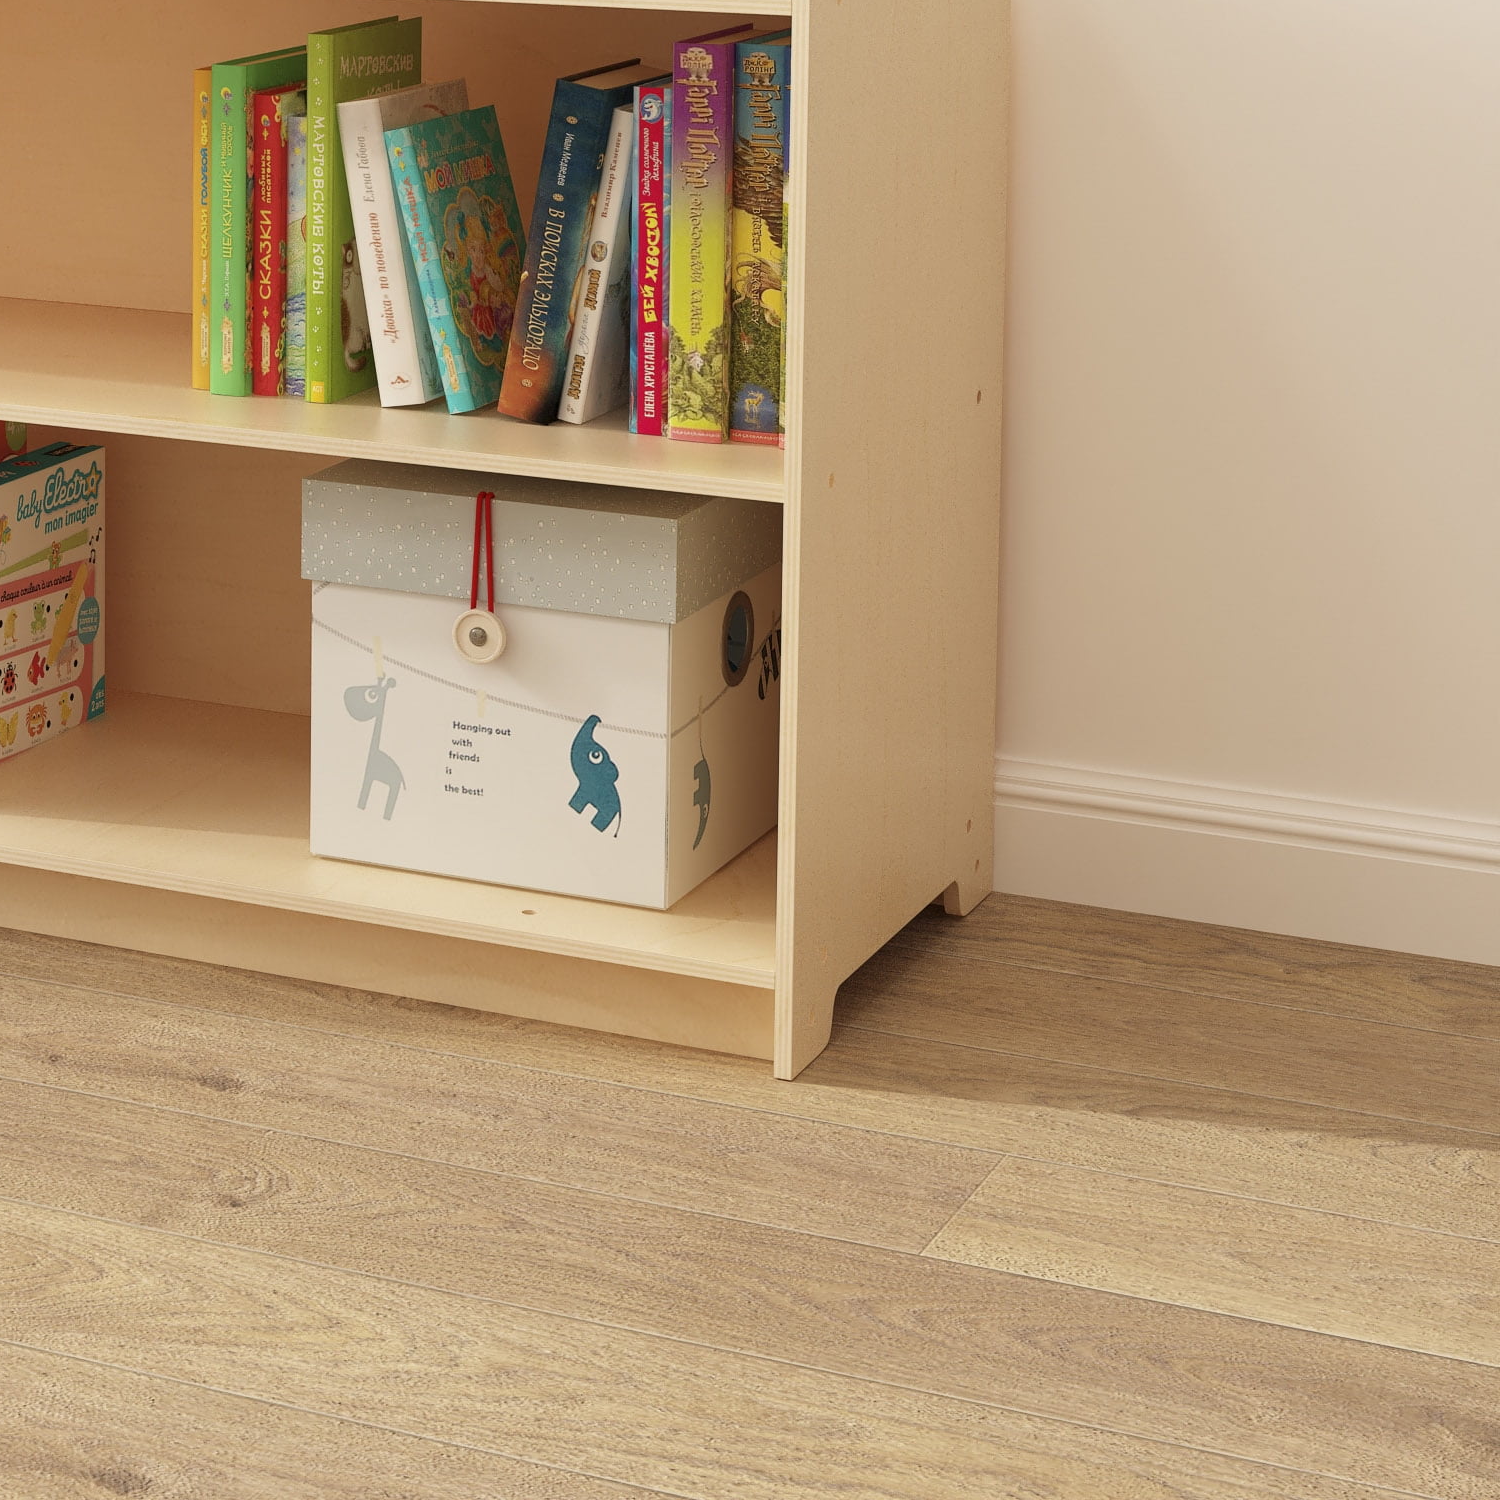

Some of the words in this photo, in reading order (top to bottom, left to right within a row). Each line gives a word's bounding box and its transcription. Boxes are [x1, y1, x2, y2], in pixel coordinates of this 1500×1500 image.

[339, 53, 414, 79] МАРТОВСКИЕ
[564, 133, 576, 152] Иван
[651, 141, 663, 181] дельфина
[200, 148, 208, 206] ГОЛУБОЙ
[312, 115, 325, 237] МАРТОВСКИЕ
[361, 172, 376, 203] Елена
[424, 160, 455, 193] МОЙ
[453, 153, 496, 184] МИШКА
[556, 152, 573, 187] Медведев
[222, 169, 233, 258] ЩЕЛКУНЧИК
[404, 176, 421, 228] МИШКА
[548, 206, 566, 219] В
[601, 173, 616, 218] Владимир
[200, 209, 208, 257] СКАЗКИ
[369, 212, 386, 273] поведению
[259, 209, 272, 300] СКАЗКИ
[312, 243, 324, 295] КОТЫ
[536, 220, 563, 290] ПОИСКАХ
[379, 276, 389, 290] по
[584, 268, 601, 311] ДОМОЙ
[639, 285, 658, 323] БЕЙ
[522, 290, 552, 371] ЭЛЬДОРАДО
[644, 331, 656, 389] ХРУСТАЛЁВА
[644, 390, 656, 418] ЕЛЕНА
[17, 490, 43, 529] baby
[43, 461, 103, 514] Electro
[45, 518, 63, 535] mon
[65, 502, 99, 525] imagier
[1, 590, 20, 607] chaque
[21, 582, 42, 599] couleur
[452, 720, 493, 735] Hanging
[495, 728, 511, 736] out
[452, 739, 472, 747] with
[445, 766, 452, 775] is
[449, 750, 480, 762] friends
[444, 784, 459, 793] the
[462, 785, 484, 796] best!
